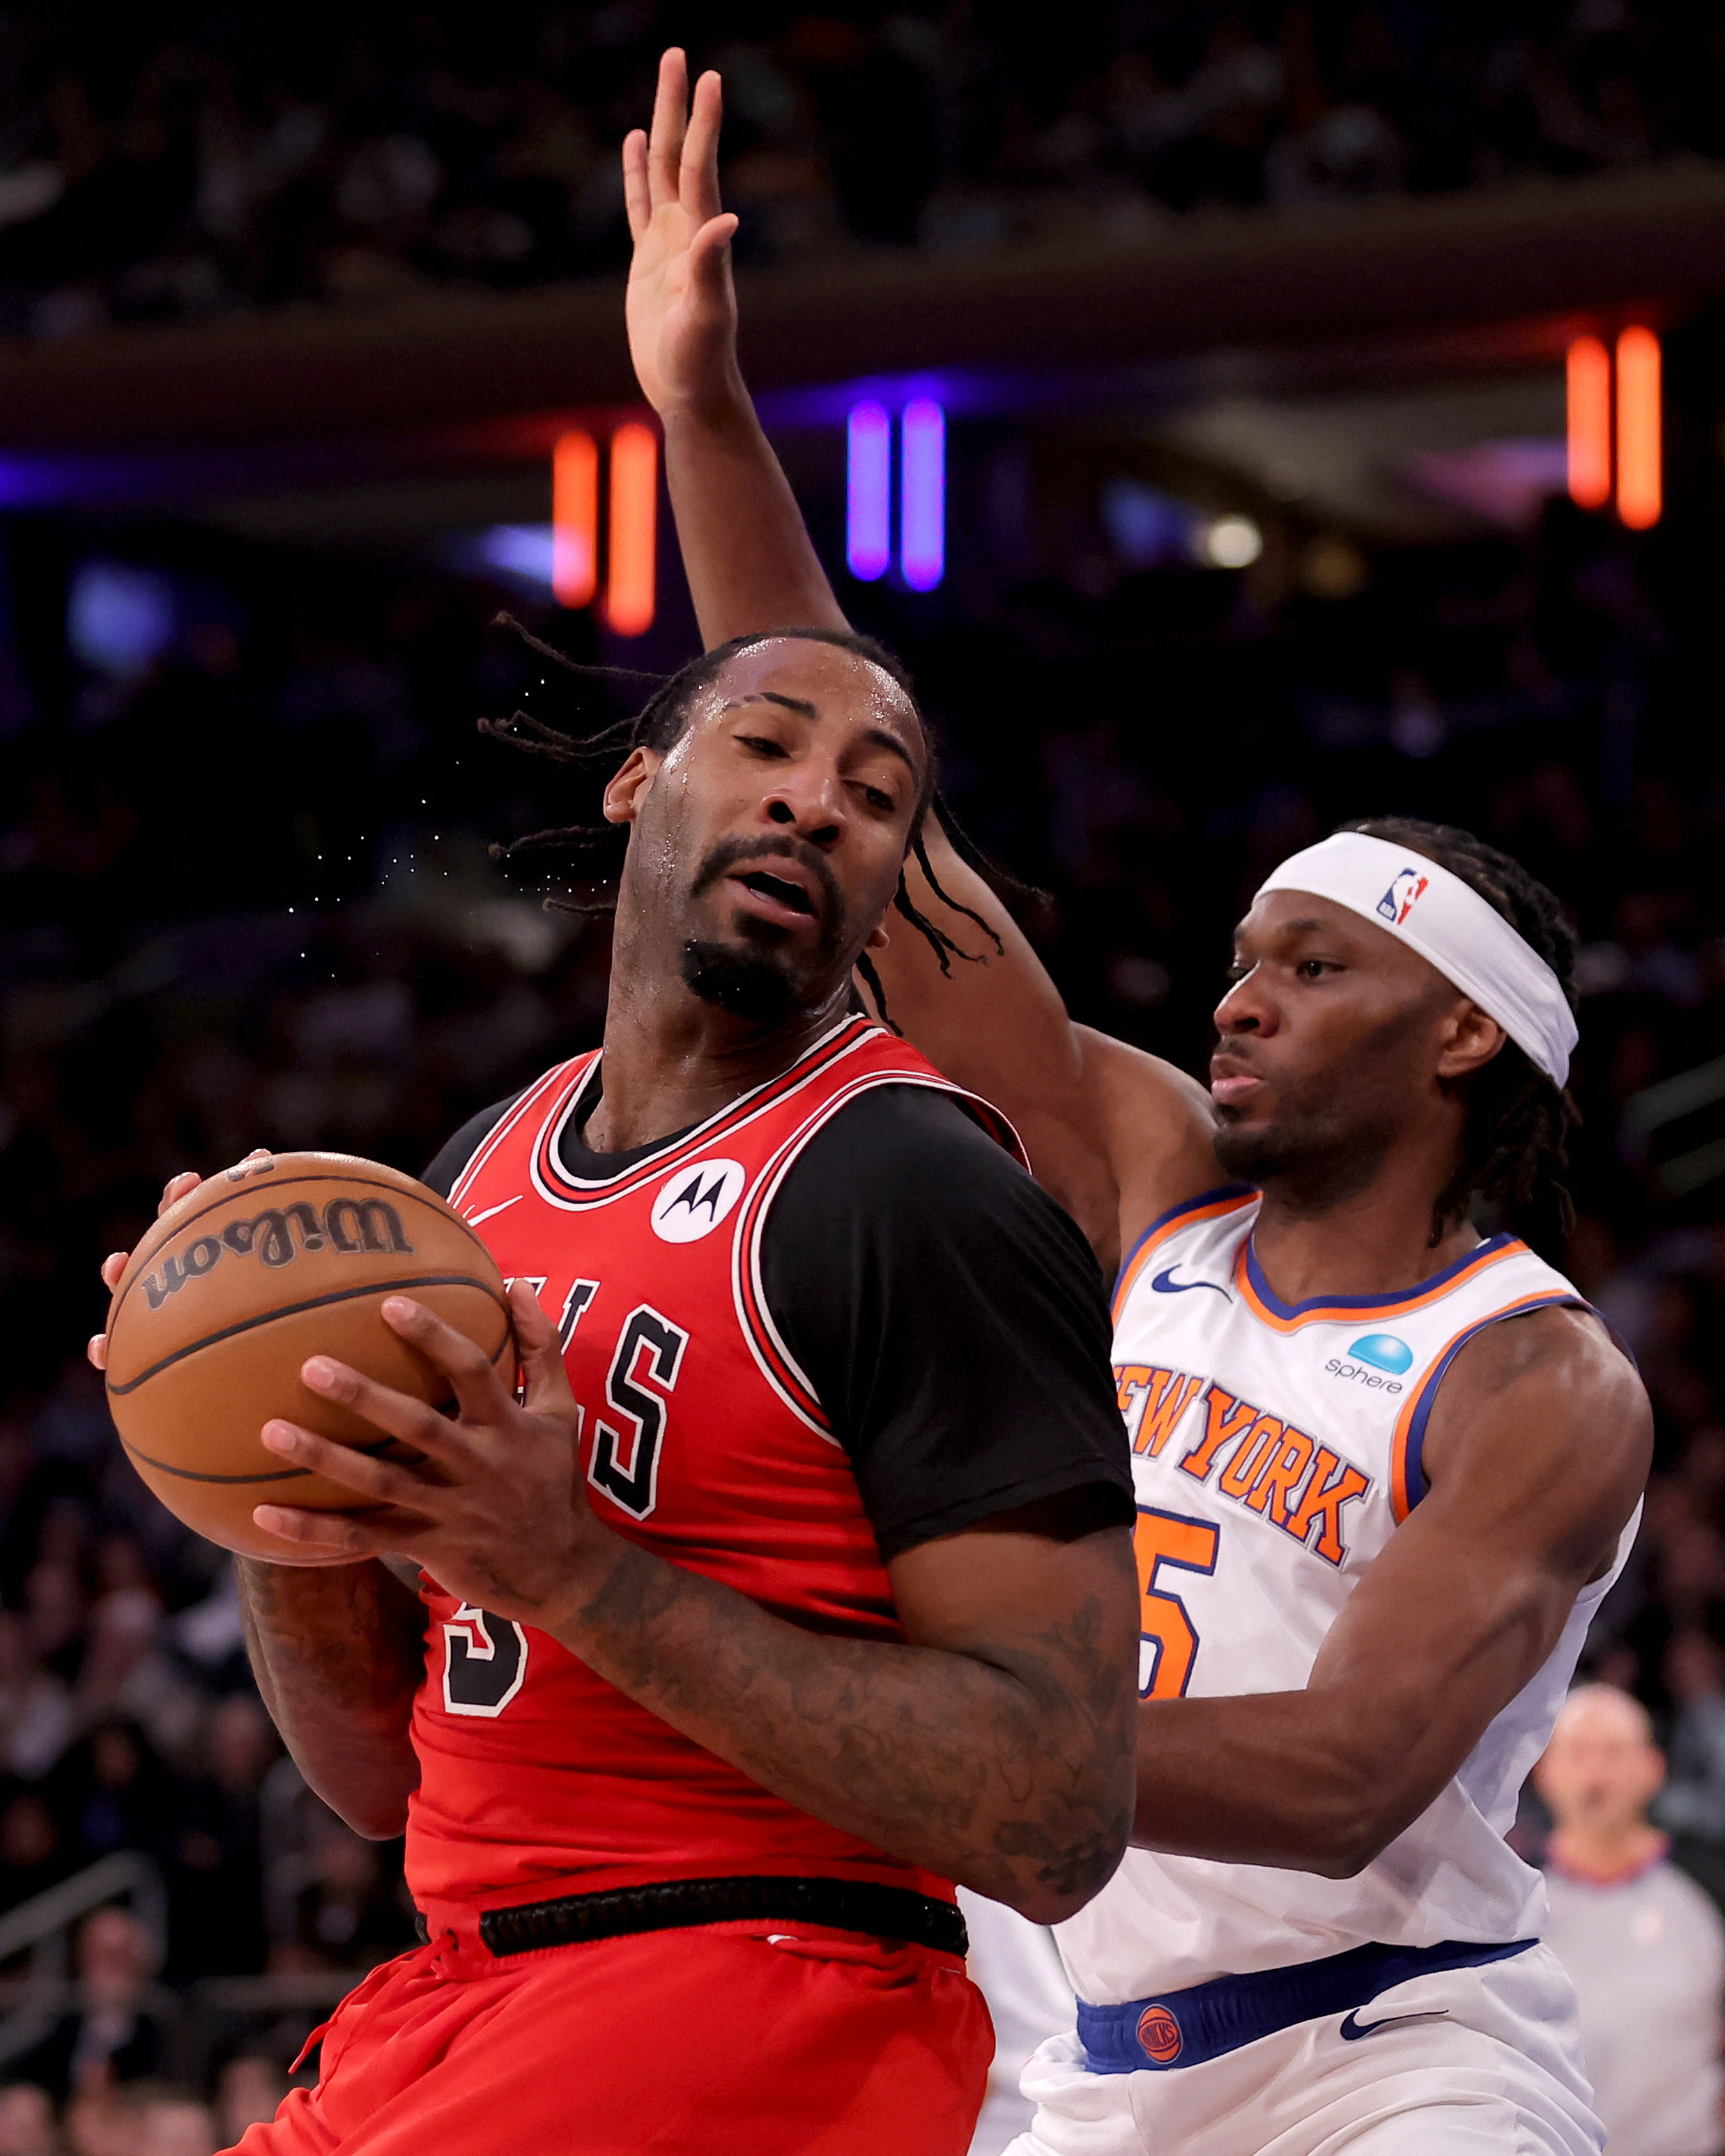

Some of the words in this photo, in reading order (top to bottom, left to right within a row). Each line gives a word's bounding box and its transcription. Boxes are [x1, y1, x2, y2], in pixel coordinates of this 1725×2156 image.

[141, 1196, 415, 1311] Wilson
[1324, 1358, 1403, 1394] sphere
[1112, 1364, 1204, 1458] EW
[1179, 1382, 1370, 1569] YORK
